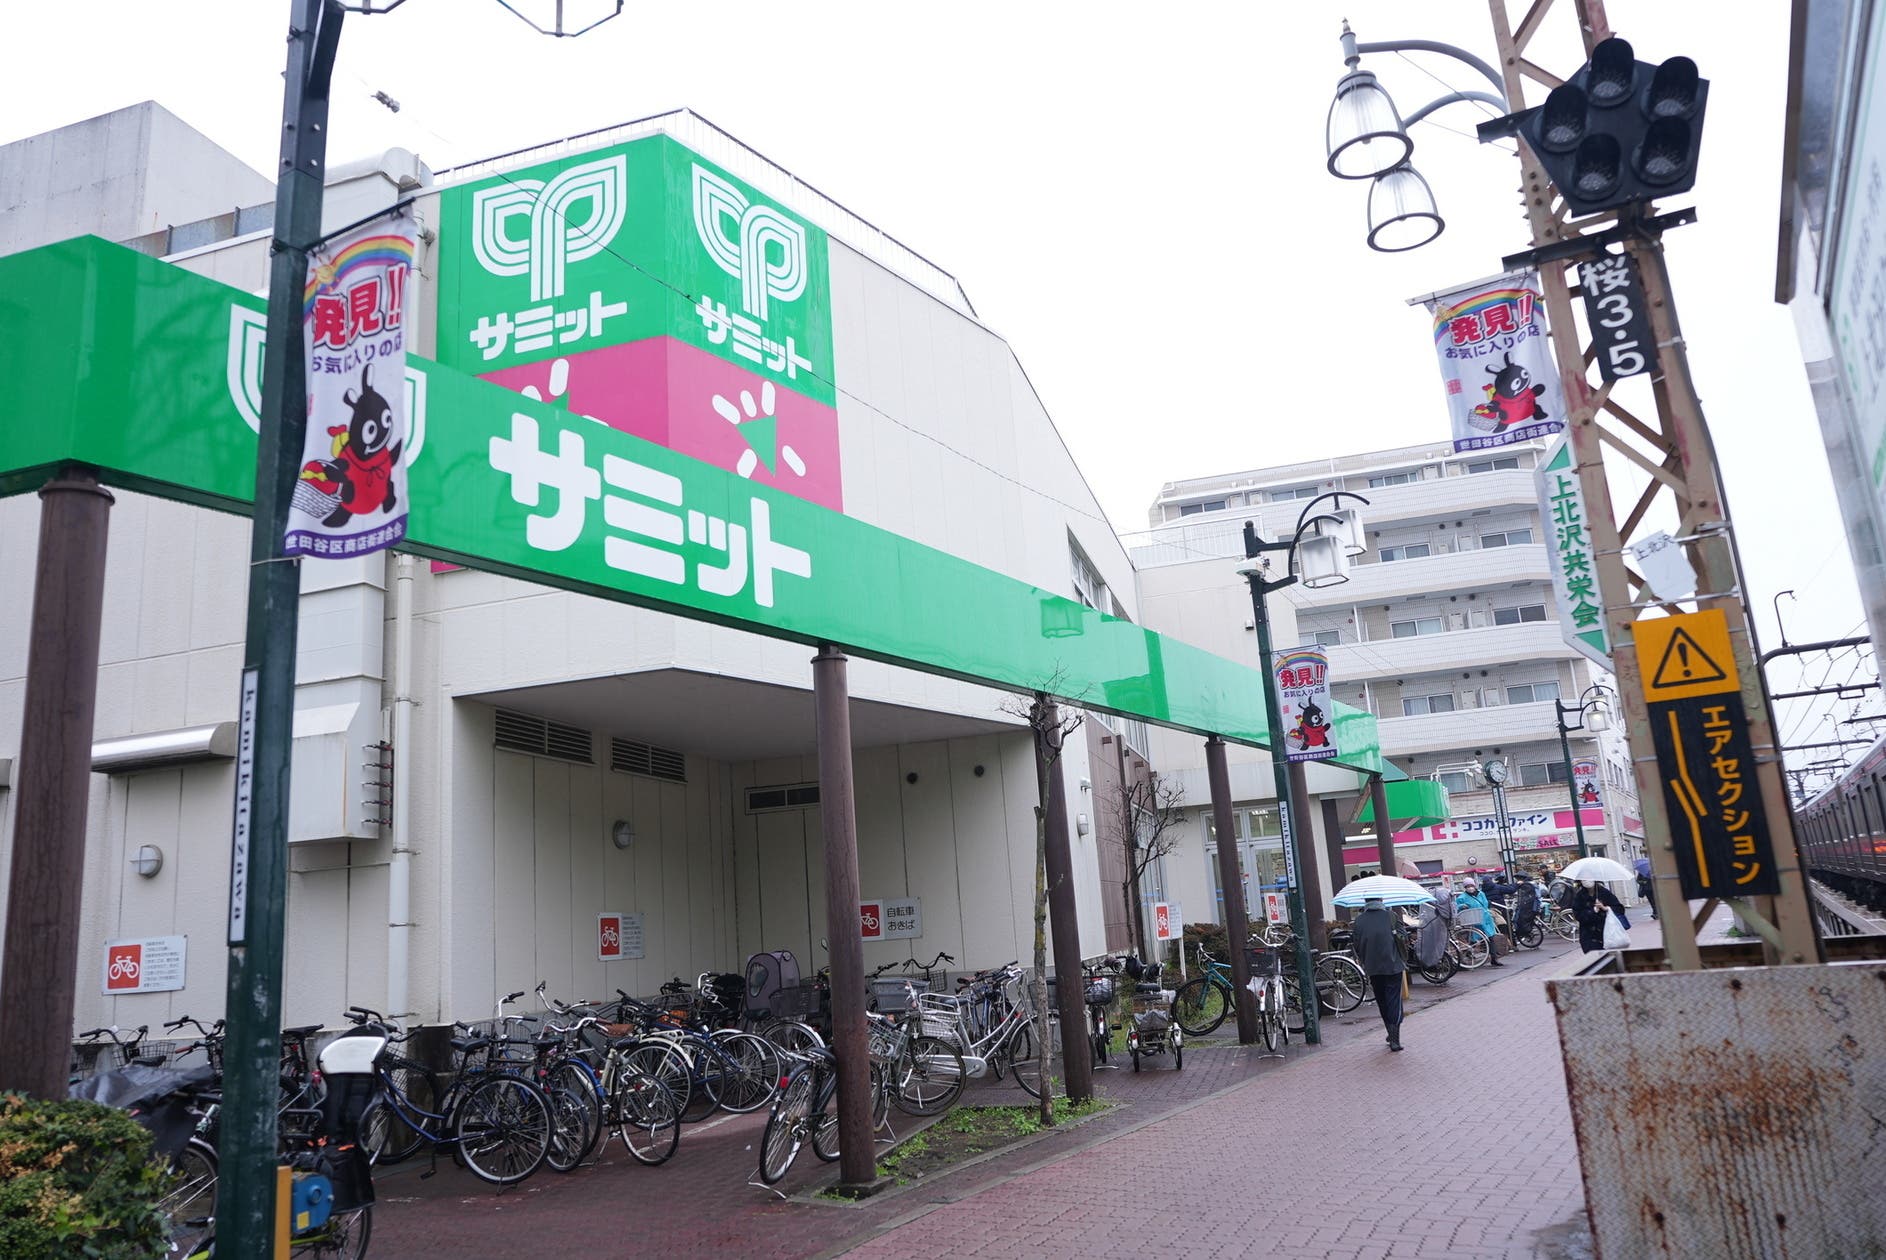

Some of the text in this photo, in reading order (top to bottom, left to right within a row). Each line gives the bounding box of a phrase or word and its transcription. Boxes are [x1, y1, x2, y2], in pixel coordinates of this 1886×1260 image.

[469, 291, 628, 361] サミット
[695, 294, 813, 380] サミット
[1444, 324, 1541, 360] お気に入りの店
[488, 411, 812, 608] サミット
[1550, 474, 1601, 629] 上北沢共栄会
[1461, 814, 1548, 832] ココカファイン
[1701, 705, 1761, 886] エアセクション
[887, 919, 916, 931] おきば
